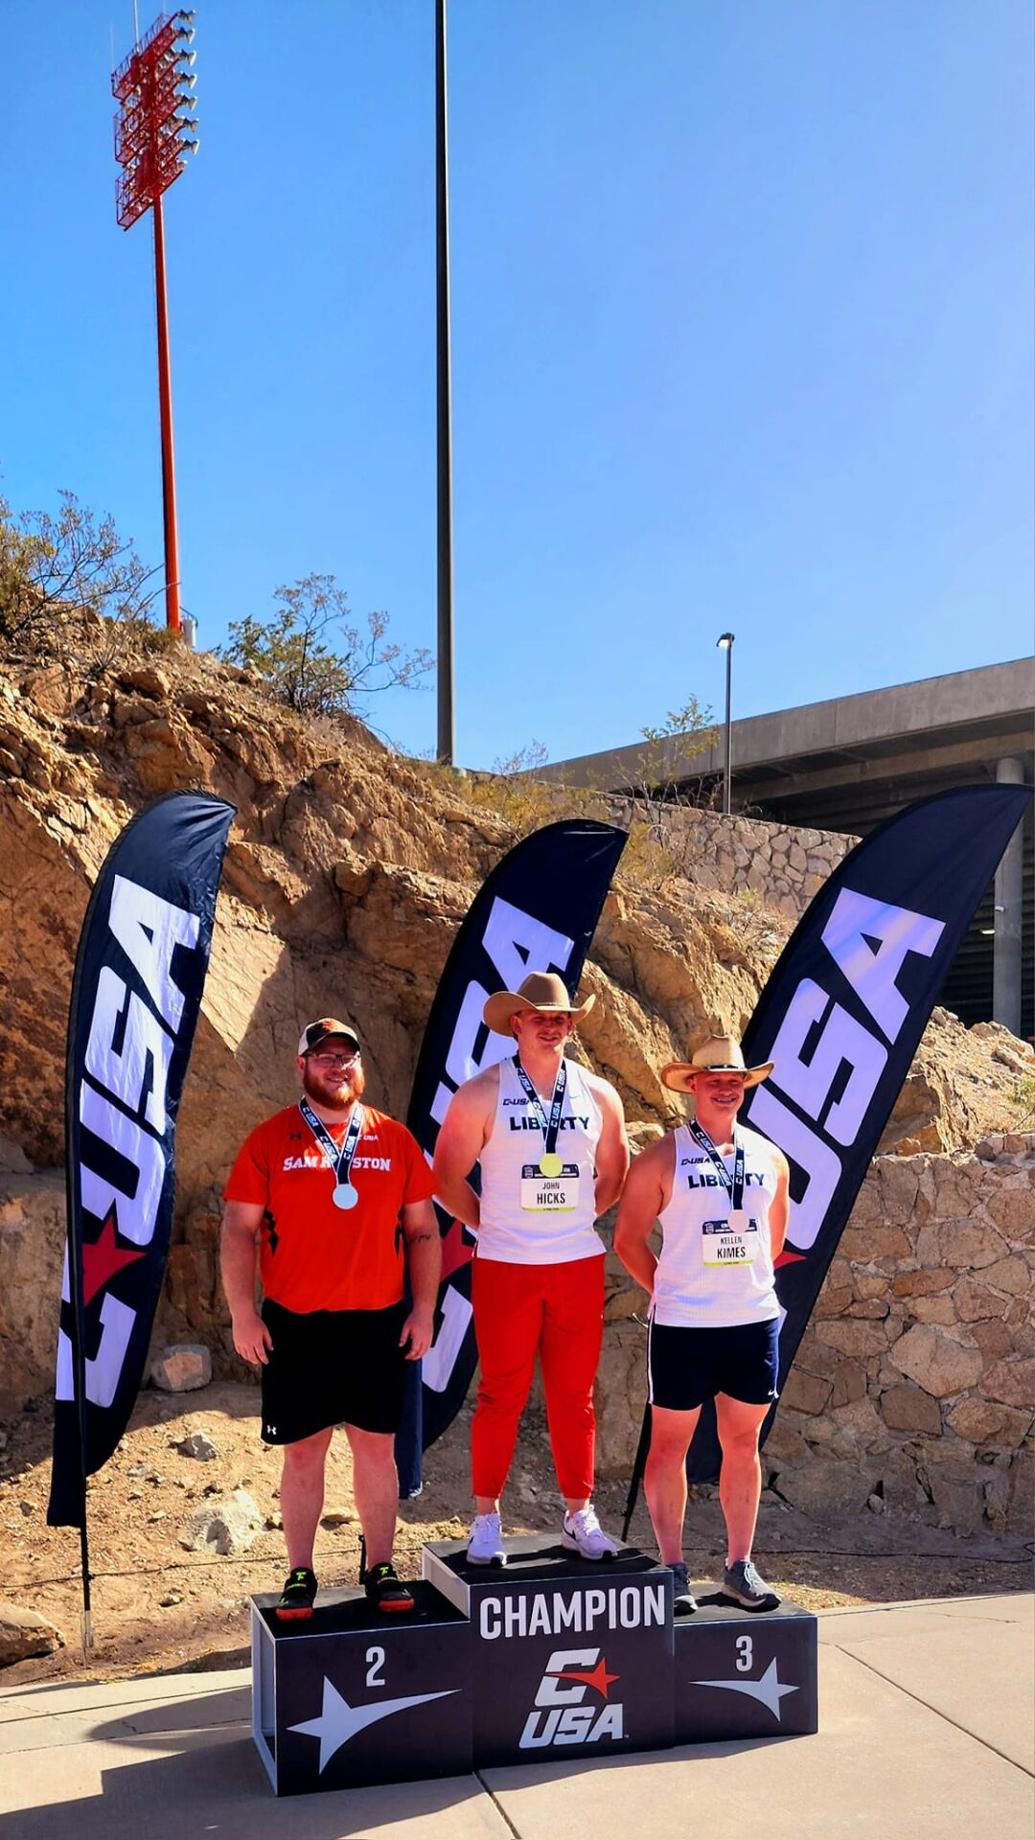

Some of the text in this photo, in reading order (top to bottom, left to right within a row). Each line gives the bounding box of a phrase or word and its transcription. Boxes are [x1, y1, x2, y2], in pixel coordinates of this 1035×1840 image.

[79, 873, 201, 1247] USA
[552, 1102, 561, 1119] USA
[283, 1156, 392, 1171] SAM HSTON
[536, 1192, 566, 1204] HICKS
[542, 1182, 560, 1190] JOHN
[717, 1247, 746, 1259] KIMES
[480, 1585, 665, 1640] CHAMPION
[365, 1646, 386, 1687] 2
[735, 1635, 753, 1672] 3
[519, 1703, 624, 1749] USA
